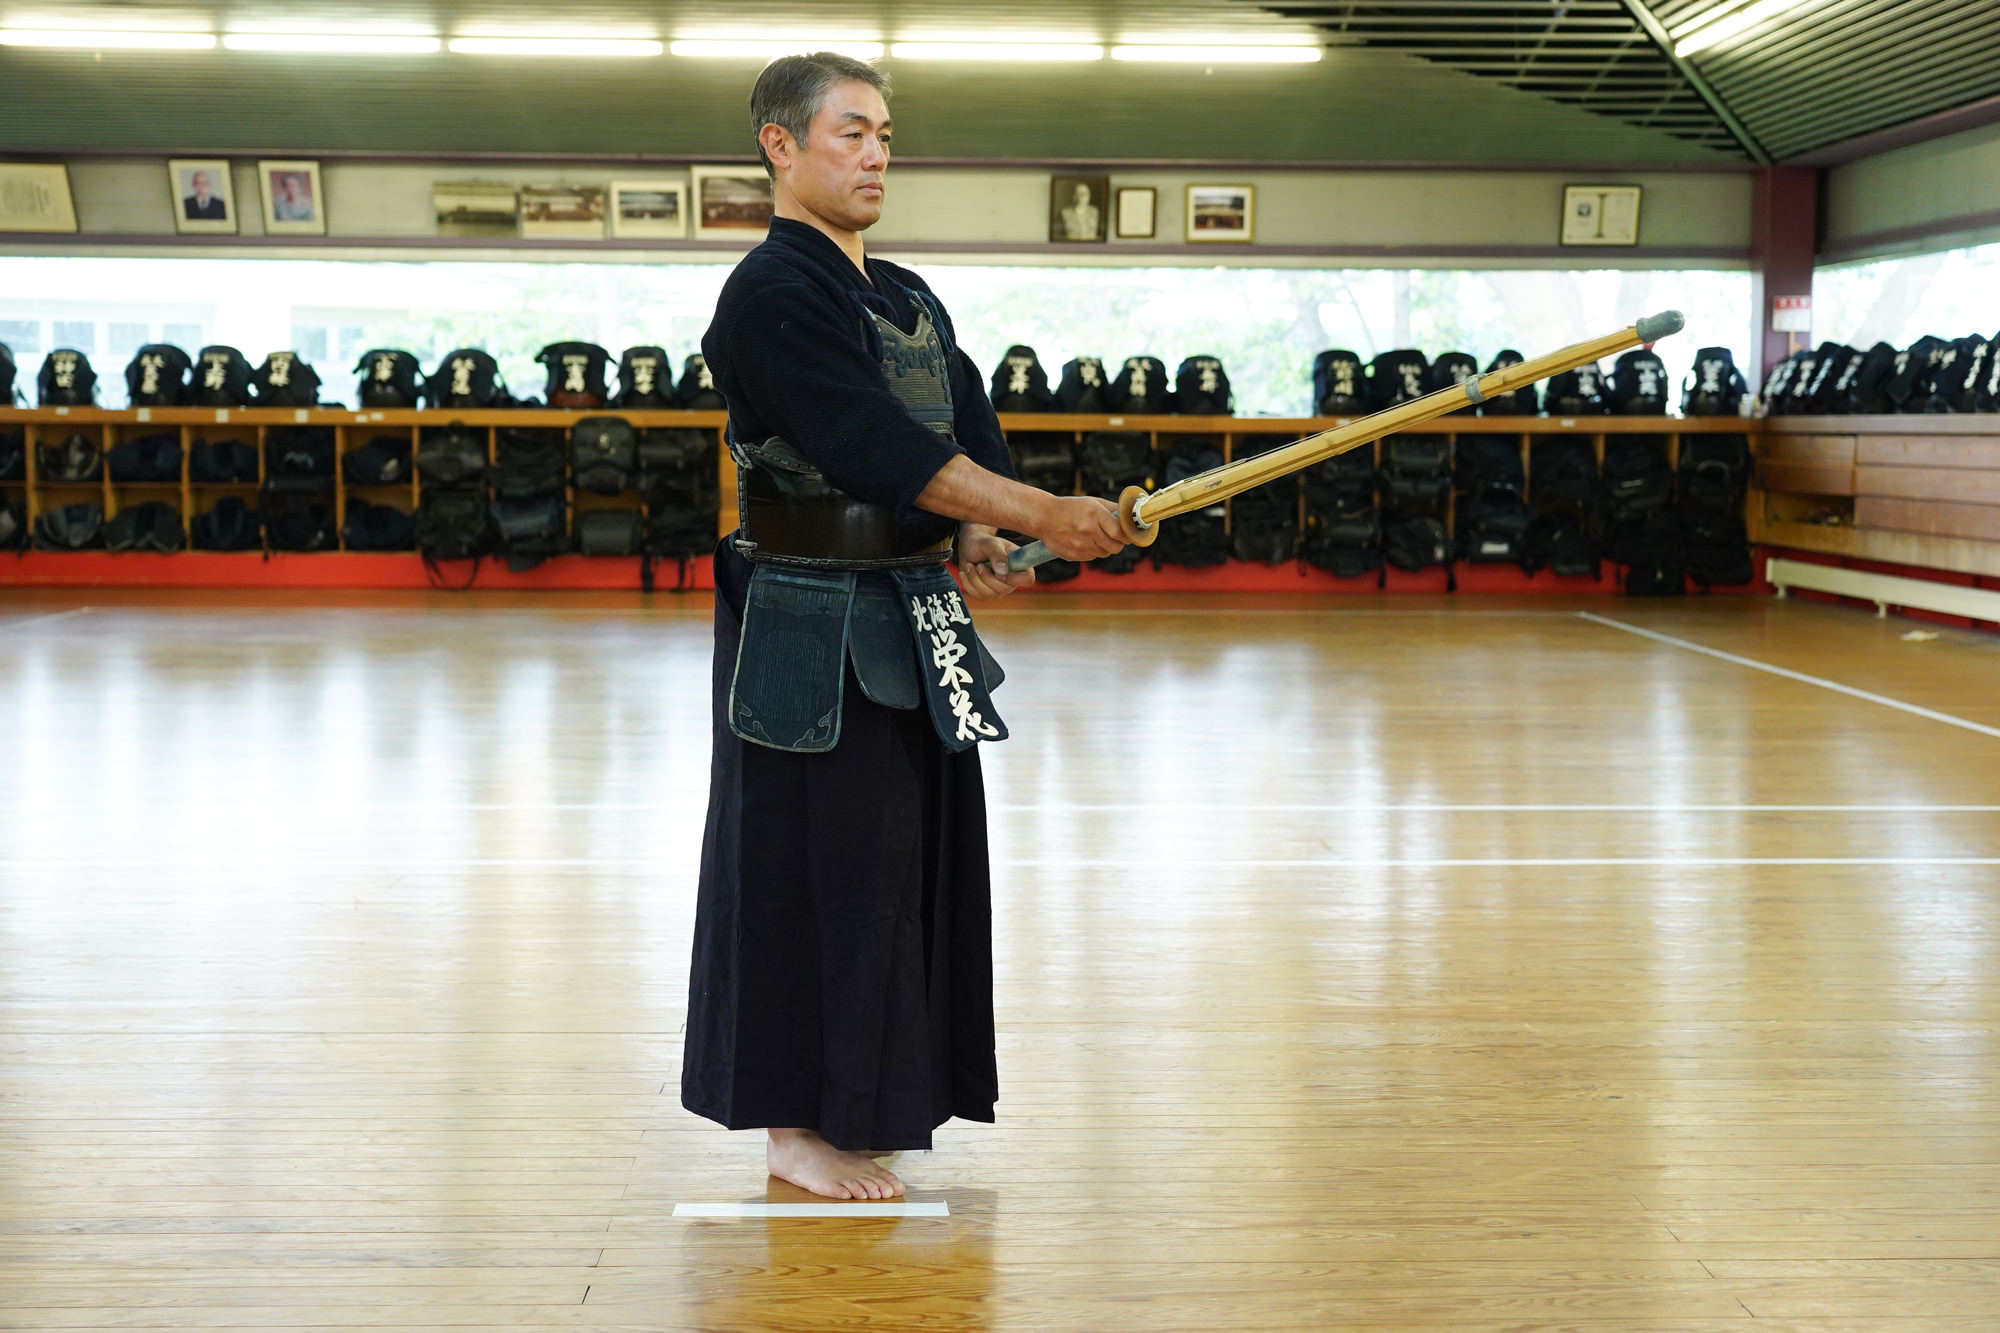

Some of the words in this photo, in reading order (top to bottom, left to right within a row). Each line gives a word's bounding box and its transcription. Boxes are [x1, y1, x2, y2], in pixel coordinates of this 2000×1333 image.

[911, 590, 971, 632] 北海道
[930, 628, 999, 741] 栄花
